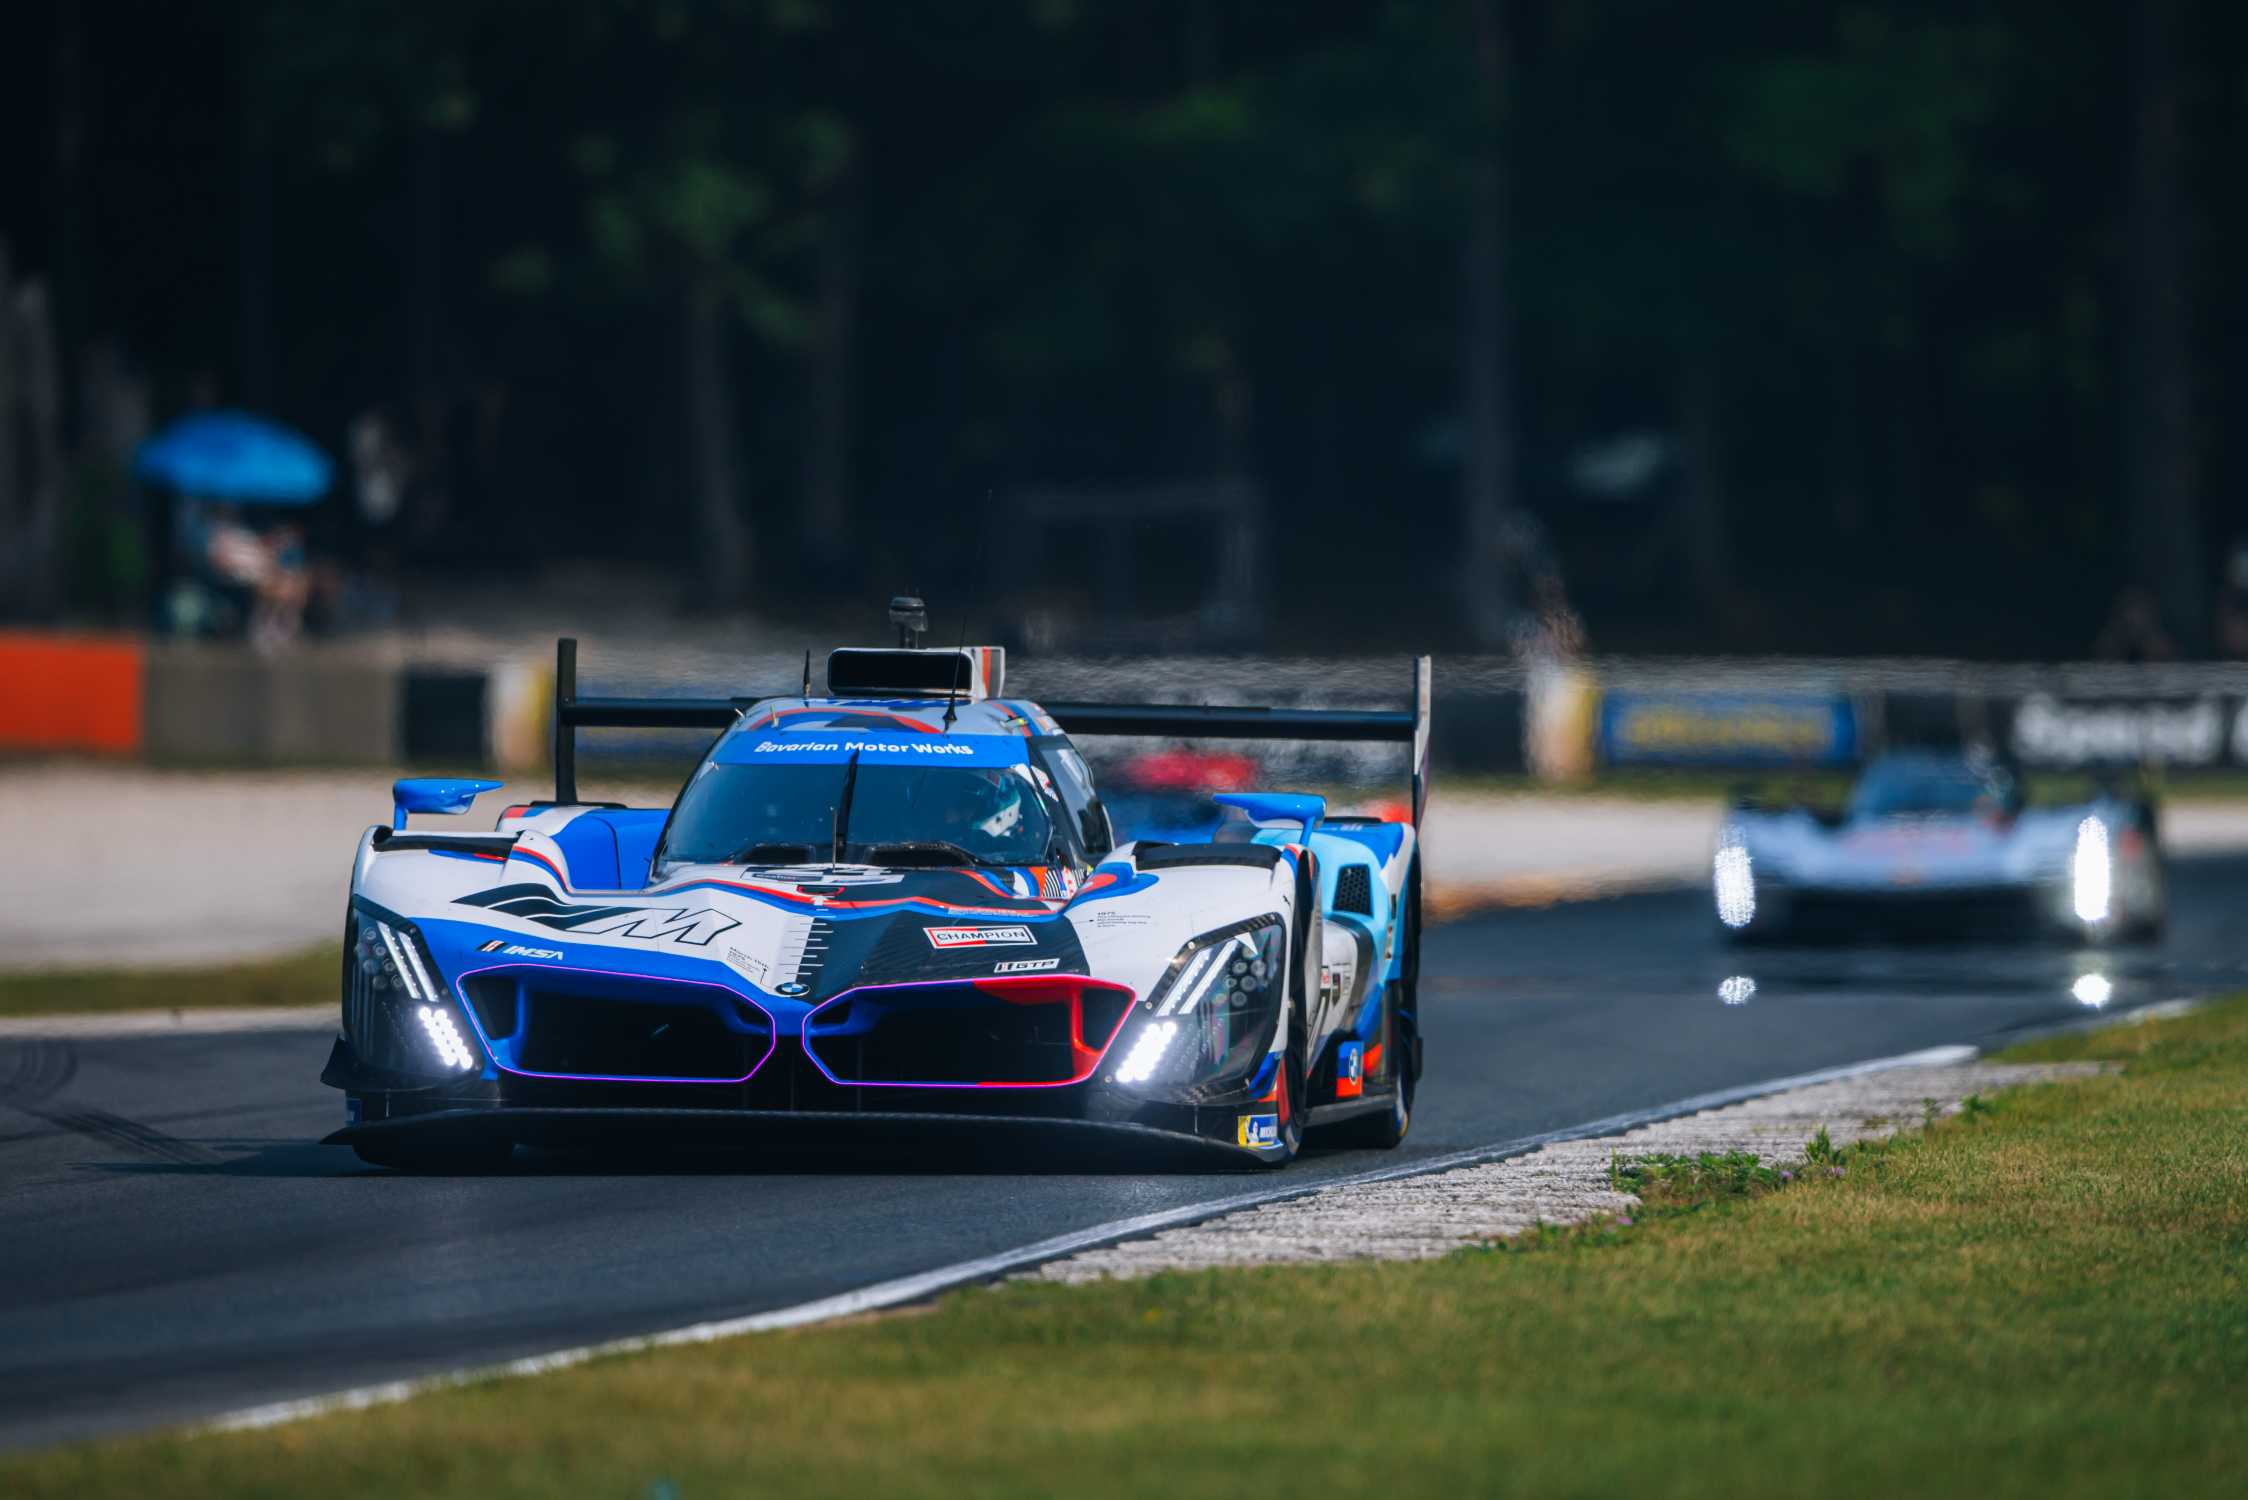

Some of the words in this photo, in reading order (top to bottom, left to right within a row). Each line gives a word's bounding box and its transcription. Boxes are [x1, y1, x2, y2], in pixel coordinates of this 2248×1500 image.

[754, 741, 838, 753] Bavarian
[844, 741, 909, 753] Motor
[910, 742, 974, 755] Works
[936, 930, 1025, 941] CHAMPION
[503, 946, 563, 960] IMSA
[1015, 960, 1055, 969] GTP
